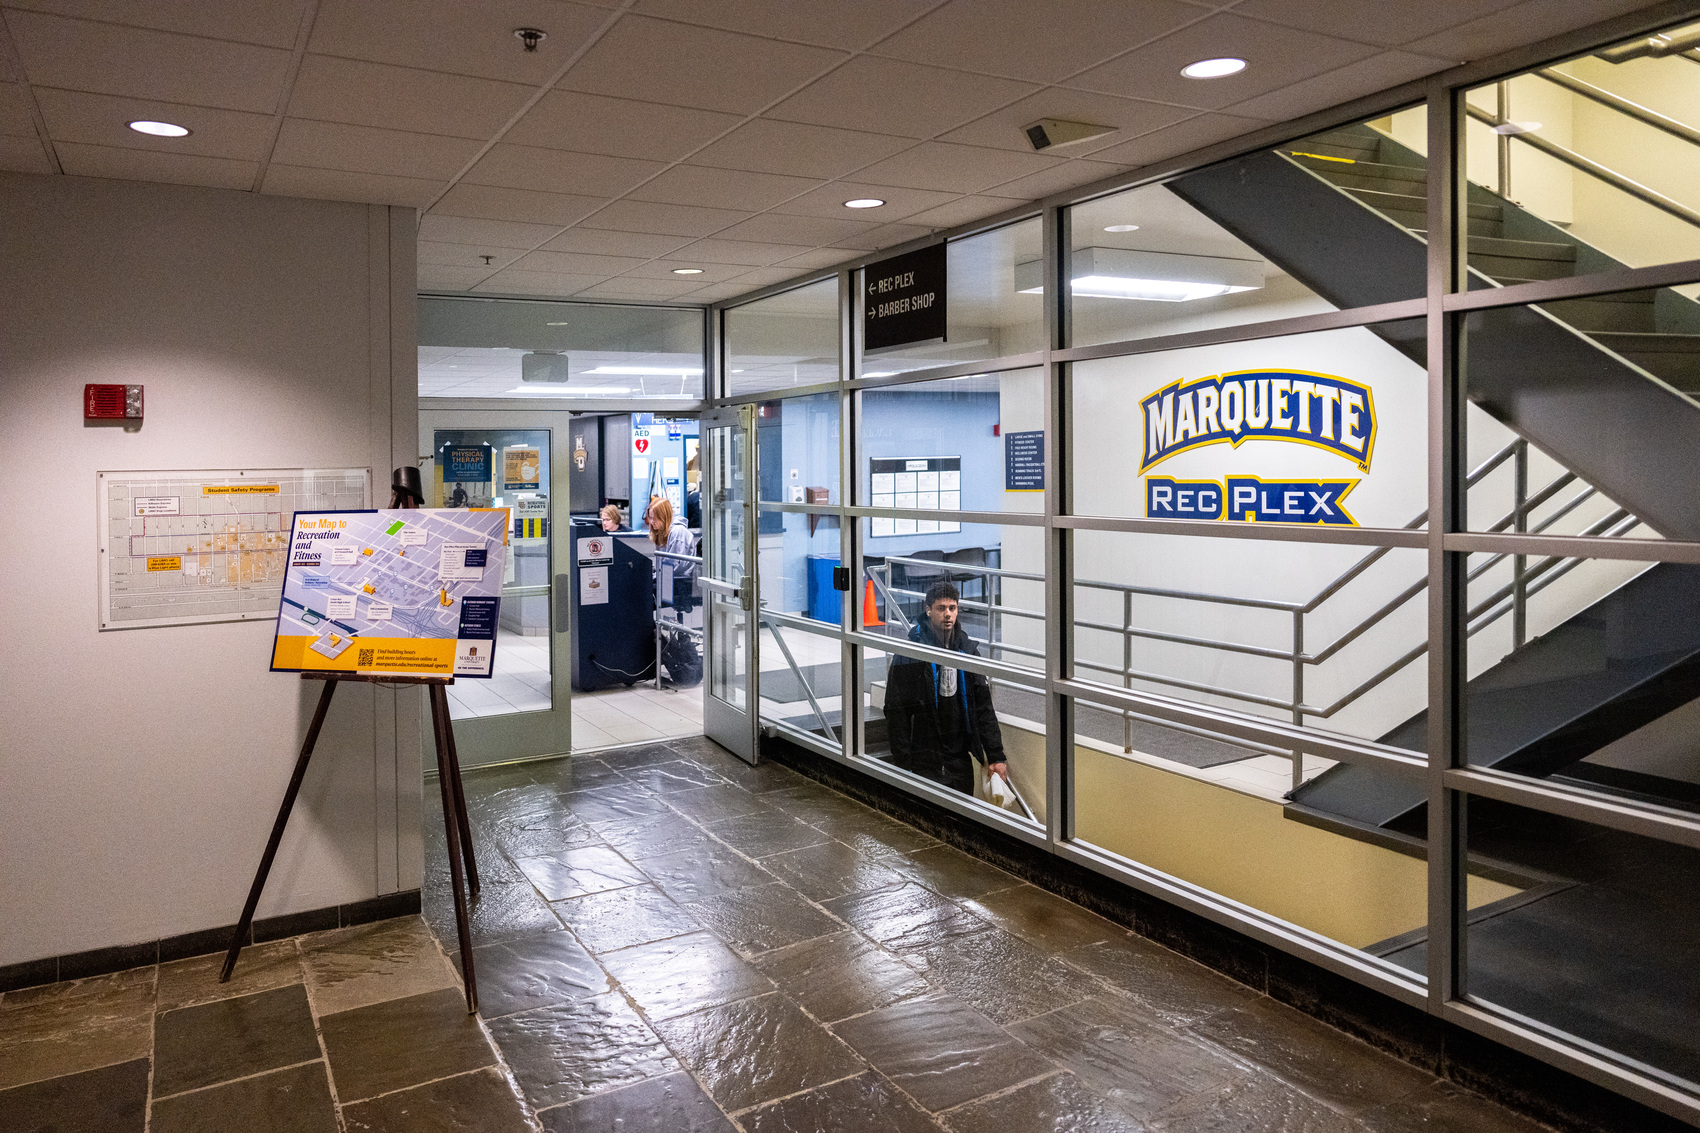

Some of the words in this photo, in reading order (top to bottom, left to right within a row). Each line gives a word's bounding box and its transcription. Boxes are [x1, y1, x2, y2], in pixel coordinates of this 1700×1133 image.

[878, 277, 893, 293] REC
[895, 271, 914, 289] PLEX
[878, 298, 910, 318] BARBER
[911, 292, 935, 311] SHOP
[1147, 378, 1366, 459] MARQUETTE
[299, 519, 317, 529] Your
[318, 519, 337, 531] Map
[339, 520, 347, 528] to
[297, 530, 340, 540] Recreation
[295, 541, 312, 549] and
[294, 551, 322, 560] Fitness
